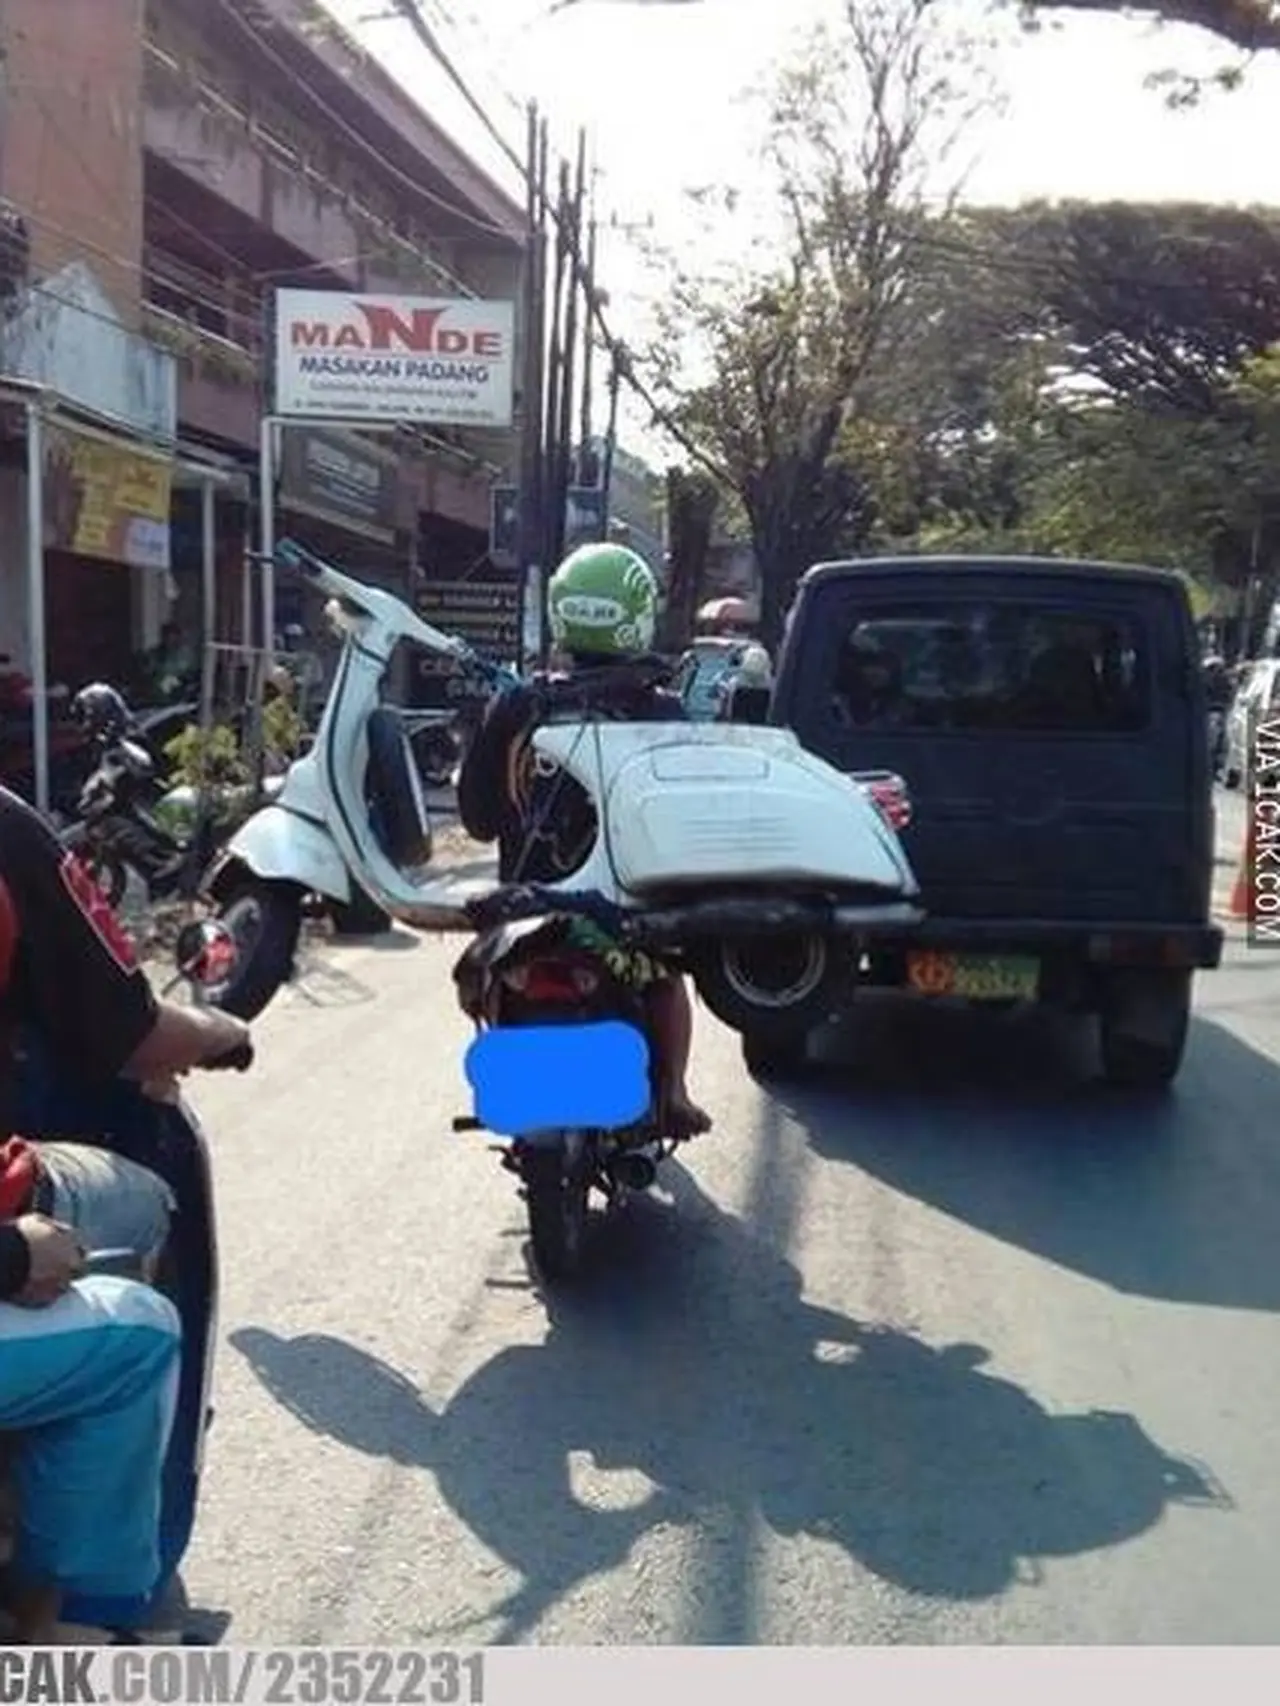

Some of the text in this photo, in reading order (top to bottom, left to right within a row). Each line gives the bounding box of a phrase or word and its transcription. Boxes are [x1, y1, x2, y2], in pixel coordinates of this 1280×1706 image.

[291, 302, 503, 356] MANDE
[299, 355, 490, 383] MASAKAN PADANG
